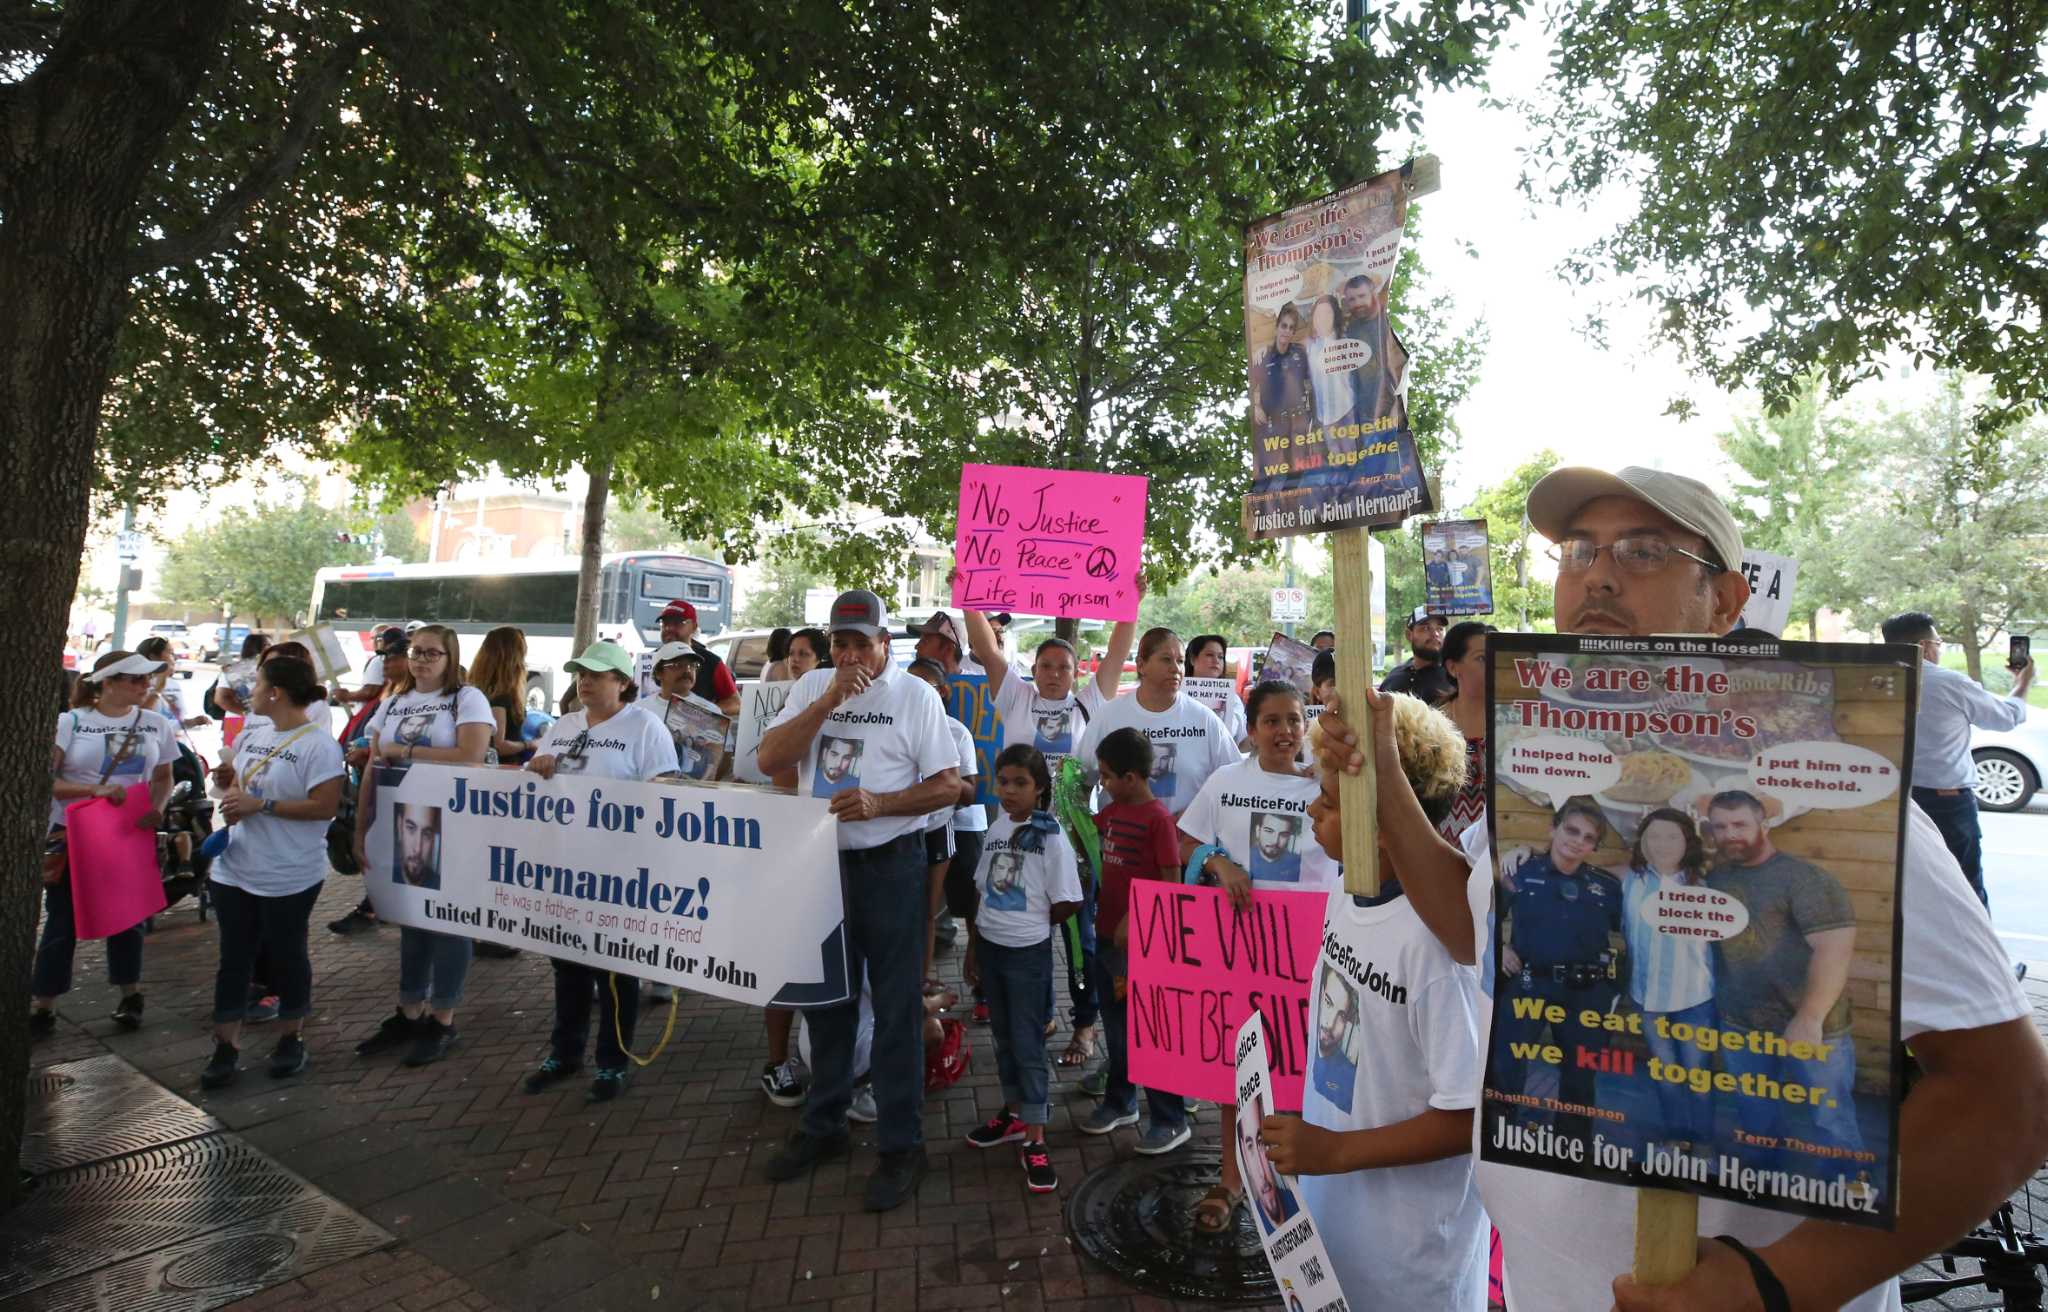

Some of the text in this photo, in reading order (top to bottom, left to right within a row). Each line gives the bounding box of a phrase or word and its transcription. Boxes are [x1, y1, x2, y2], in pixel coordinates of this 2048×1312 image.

[1254, 206, 1349, 249] We are the
[1257, 227, 1364, 273] Thompson's
[1264, 436, 1290, 452] We
[1295, 429, 1324, 446] eat
[1264, 464, 1290, 476] we
[1294, 455, 1323, 471] kill
[1300, 504, 1317, 526] for
[1321, 500, 1353, 523] John
[1030, 585, 1044, 609] in
[1767, 569, 1781, 600] A
[1654, 640, 1675, 651] on
[1680, 641, 1707, 652] the
[1514, 658, 1730, 696] We are the
[1141, 726, 1206, 739] ticeForJohn
[1513, 700, 1758, 739] Thompson's
[1512, 748, 1613, 765] I helped hold
[1512, 764, 1591, 779] him down.
[1757, 756, 1890, 775] I put him on a
[1756, 775, 1862, 792] chokehold.
[449, 777, 762, 850] Justice for John
[488, 845, 710, 921] Hernandez!
[1659, 891, 1728, 905] I tried to
[494, 887, 704, 944] He was a father, a son and a friend
[1659, 908, 1735, 922] block the
[1659, 925, 1724, 938] camera.
[424, 899, 757, 989] United For Justice, United for John
[1133, 886, 1308, 984] WE WILL
[1133, 981, 1194, 1056] NOT
[1201, 990, 1236, 1067] BE
[1512, 997, 1835, 1063] We eat together
[1509, 1042, 1837, 1109] we kill together.
[1485, 1088, 1625, 1122] Shauna Thompson
[1734, 1129, 1876, 1163] Terry Thompson
[1493, 1116, 1880, 1214] Justice for John Hernandez
